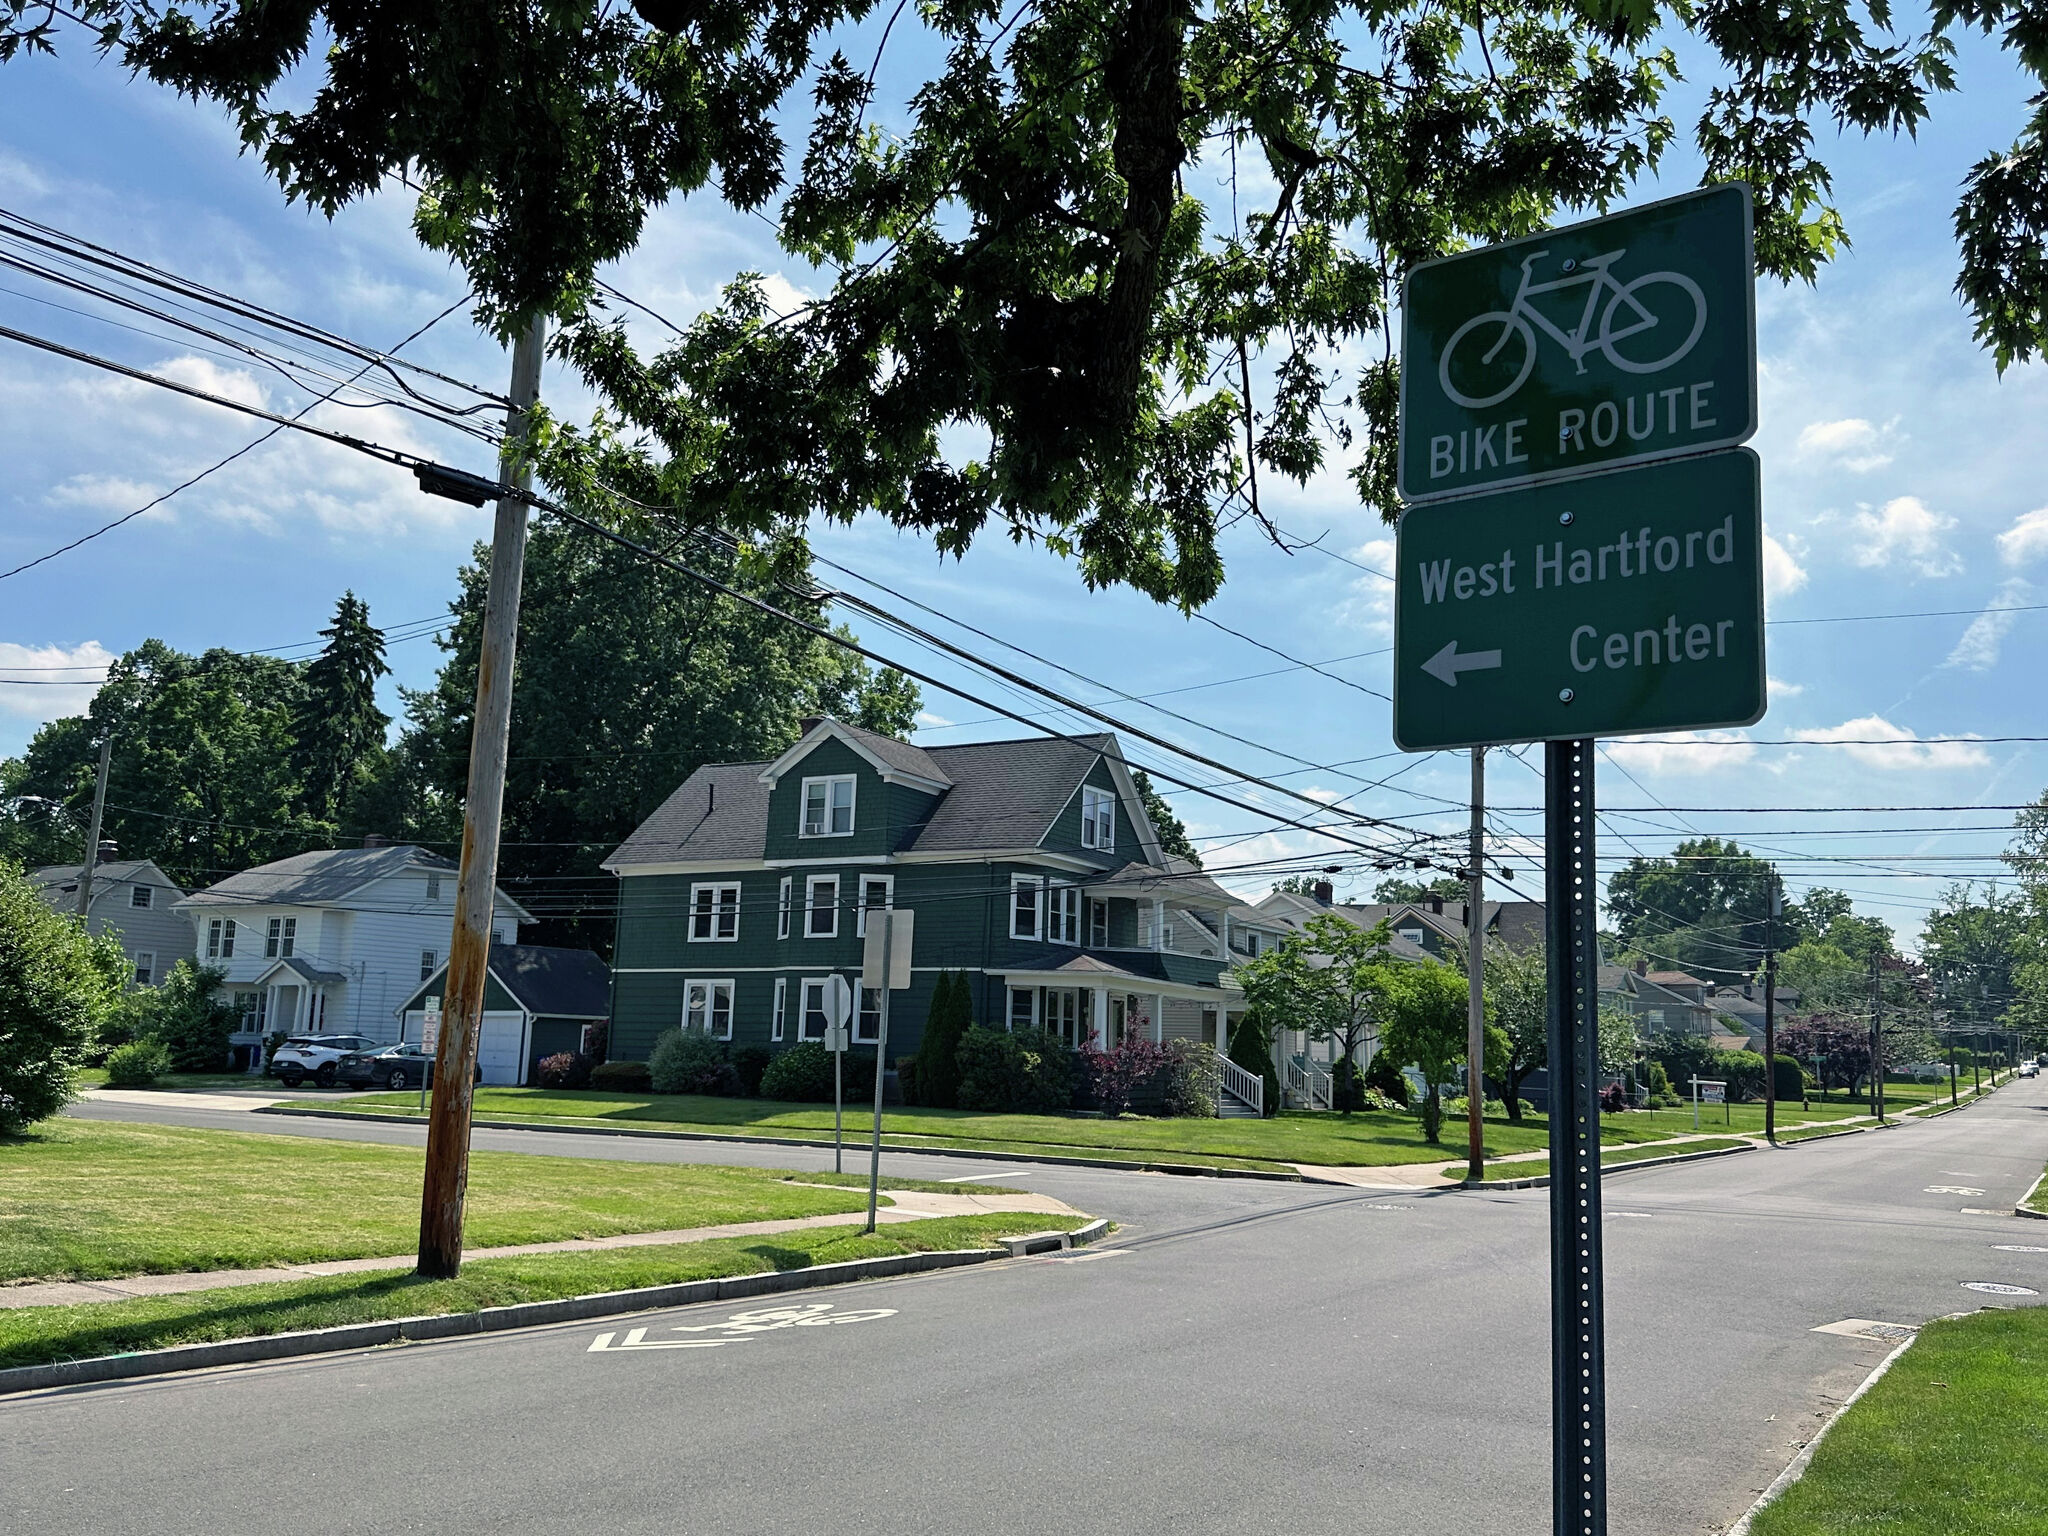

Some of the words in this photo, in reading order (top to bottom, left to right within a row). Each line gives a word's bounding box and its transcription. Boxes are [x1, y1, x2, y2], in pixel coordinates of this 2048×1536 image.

[1429, 418, 1529, 479] BIKE
[1559, 380, 1717, 455] ROUTE
[1419, 548, 1516, 604] West
[1534, 514, 1734, 590] Hartford
[1569, 613, 1734, 673] Center
